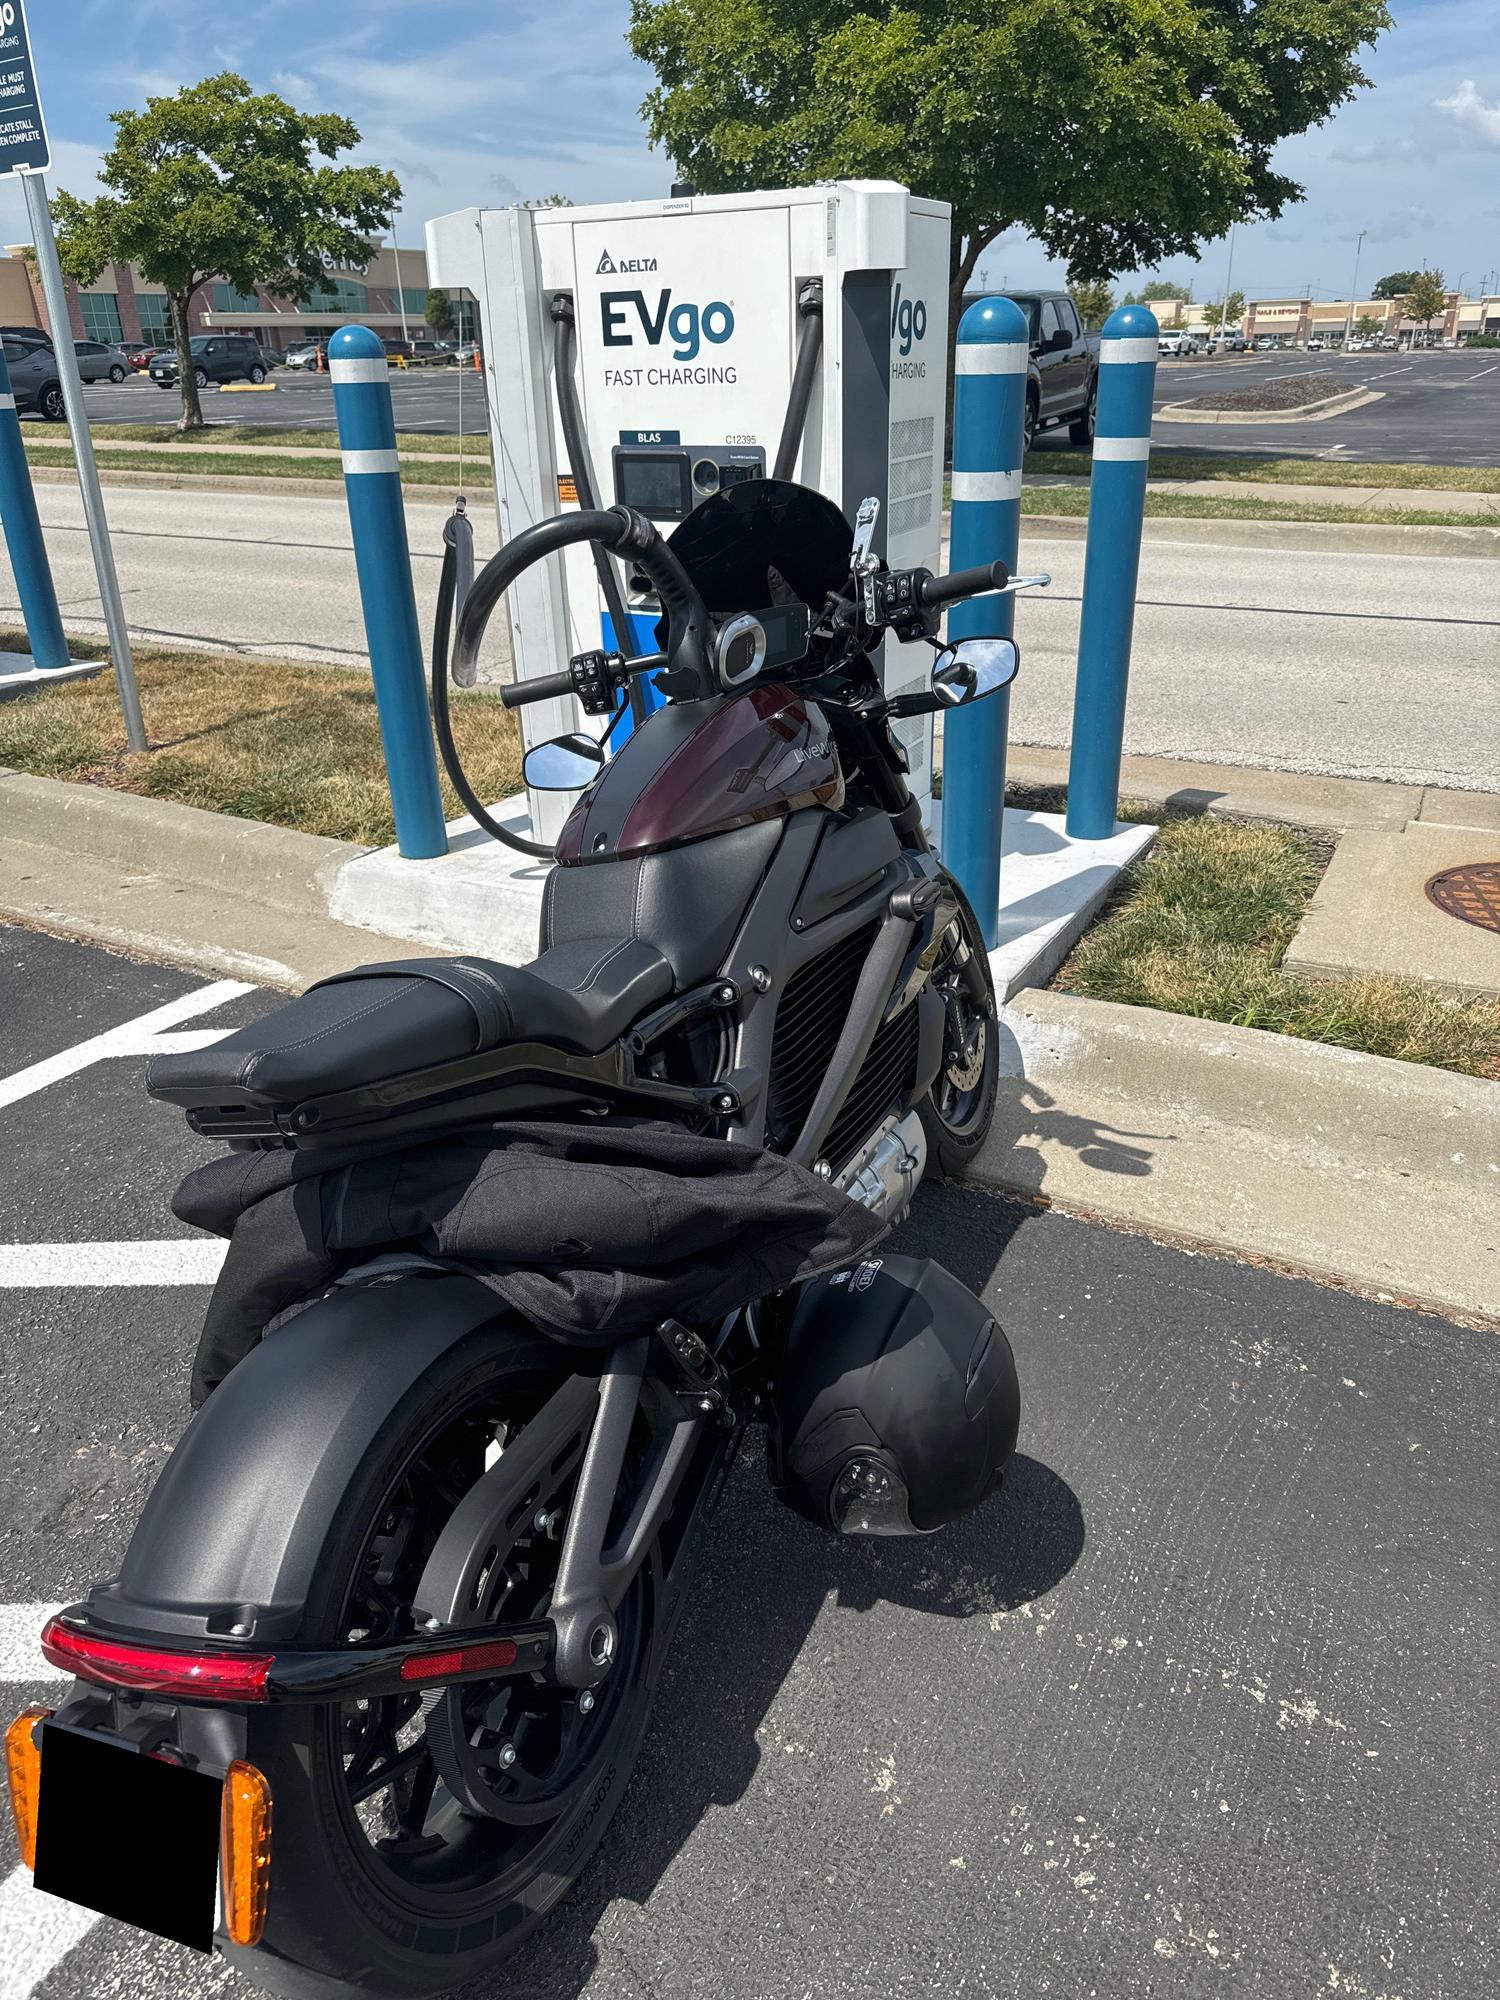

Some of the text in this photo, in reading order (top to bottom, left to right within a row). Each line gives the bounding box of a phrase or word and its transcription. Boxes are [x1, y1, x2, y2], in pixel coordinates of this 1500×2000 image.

[0, 35, 19, 48] RGING
[8, 71, 24, 83] MUST
[0, 120, 33, 133] CATE STALL
[0, 130, 40, 146] EN COMPLETE
[619, 258, 658, 273] DELTA
[599, 288, 735, 362] EVgo
[604, 366, 737, 386] FAST CHARGING
[891, 362, 926, 380] HARGING
[637, 433, 661, 443] BLAS
[725, 435, 757, 445] C12395
[858, 1261, 880, 1286] SHOEI
[566, 1762, 618, 1857] SCORCHER
